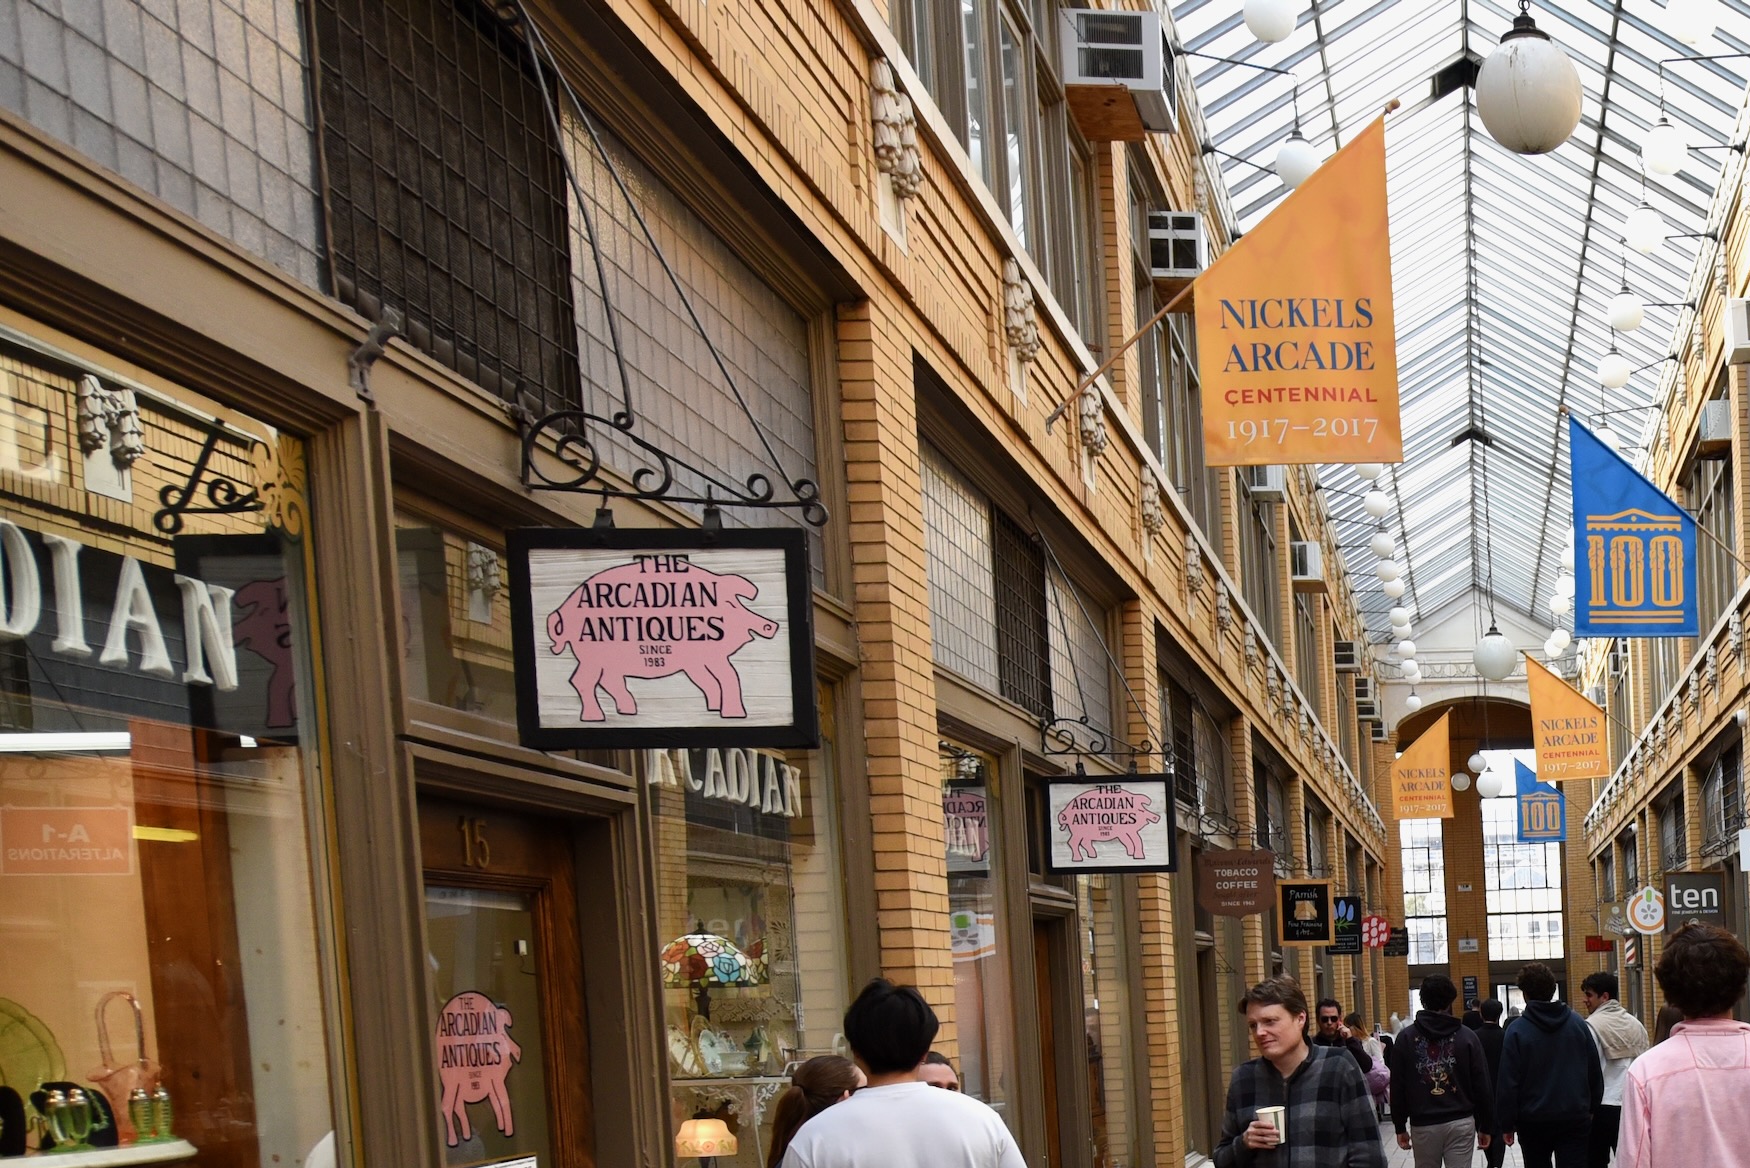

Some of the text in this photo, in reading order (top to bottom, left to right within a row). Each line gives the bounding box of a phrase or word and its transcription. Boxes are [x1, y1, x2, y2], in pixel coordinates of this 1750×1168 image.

[1219, 298, 1374, 329] NICKELS
[1223, 341, 1375, 372] ARCADE
[1225, 387, 1378, 406] CENTENNIAL
[633, 554, 689, 573] THE
[1588, 535, 1685, 607] 100
[577, 582, 717, 608] ARCADIAN
[579, 616, 725, 642] ANTIQUES
[639, 645, 672, 654] SINCE
[644, 657, 665, 667] 1983
[1541, 716, 1598, 731] NICKELS
[1542, 732, 1599, 747] ARCADE
[1543, 749, 1600, 759] CENTENNIAL
[1398, 768, 1446, 779] NICKELS
[1096, 785, 1121, 794] THE
[1399, 781, 1446, 792] ARCADE
[1072, 797, 1133, 810] ARCADIAN
[1399, 794, 1446, 802] CENTENNIAL
[1072, 813, 1136, 825] ANTIQUES
[1521, 801, 1561, 831] 100
[457, 817, 490, 868] 15
[1214, 868, 1258, 877] TOBACCO
[1216, 881, 1258, 889] COFFEE
[1289, 888, 1318, 901] Parrish
[1671, 884, 1718, 909] ten
[459, 997, 475, 1010] THE
[440, 1011, 498, 1037] ARCADIAN
[441, 1042, 502, 1068] ANTIQUES
